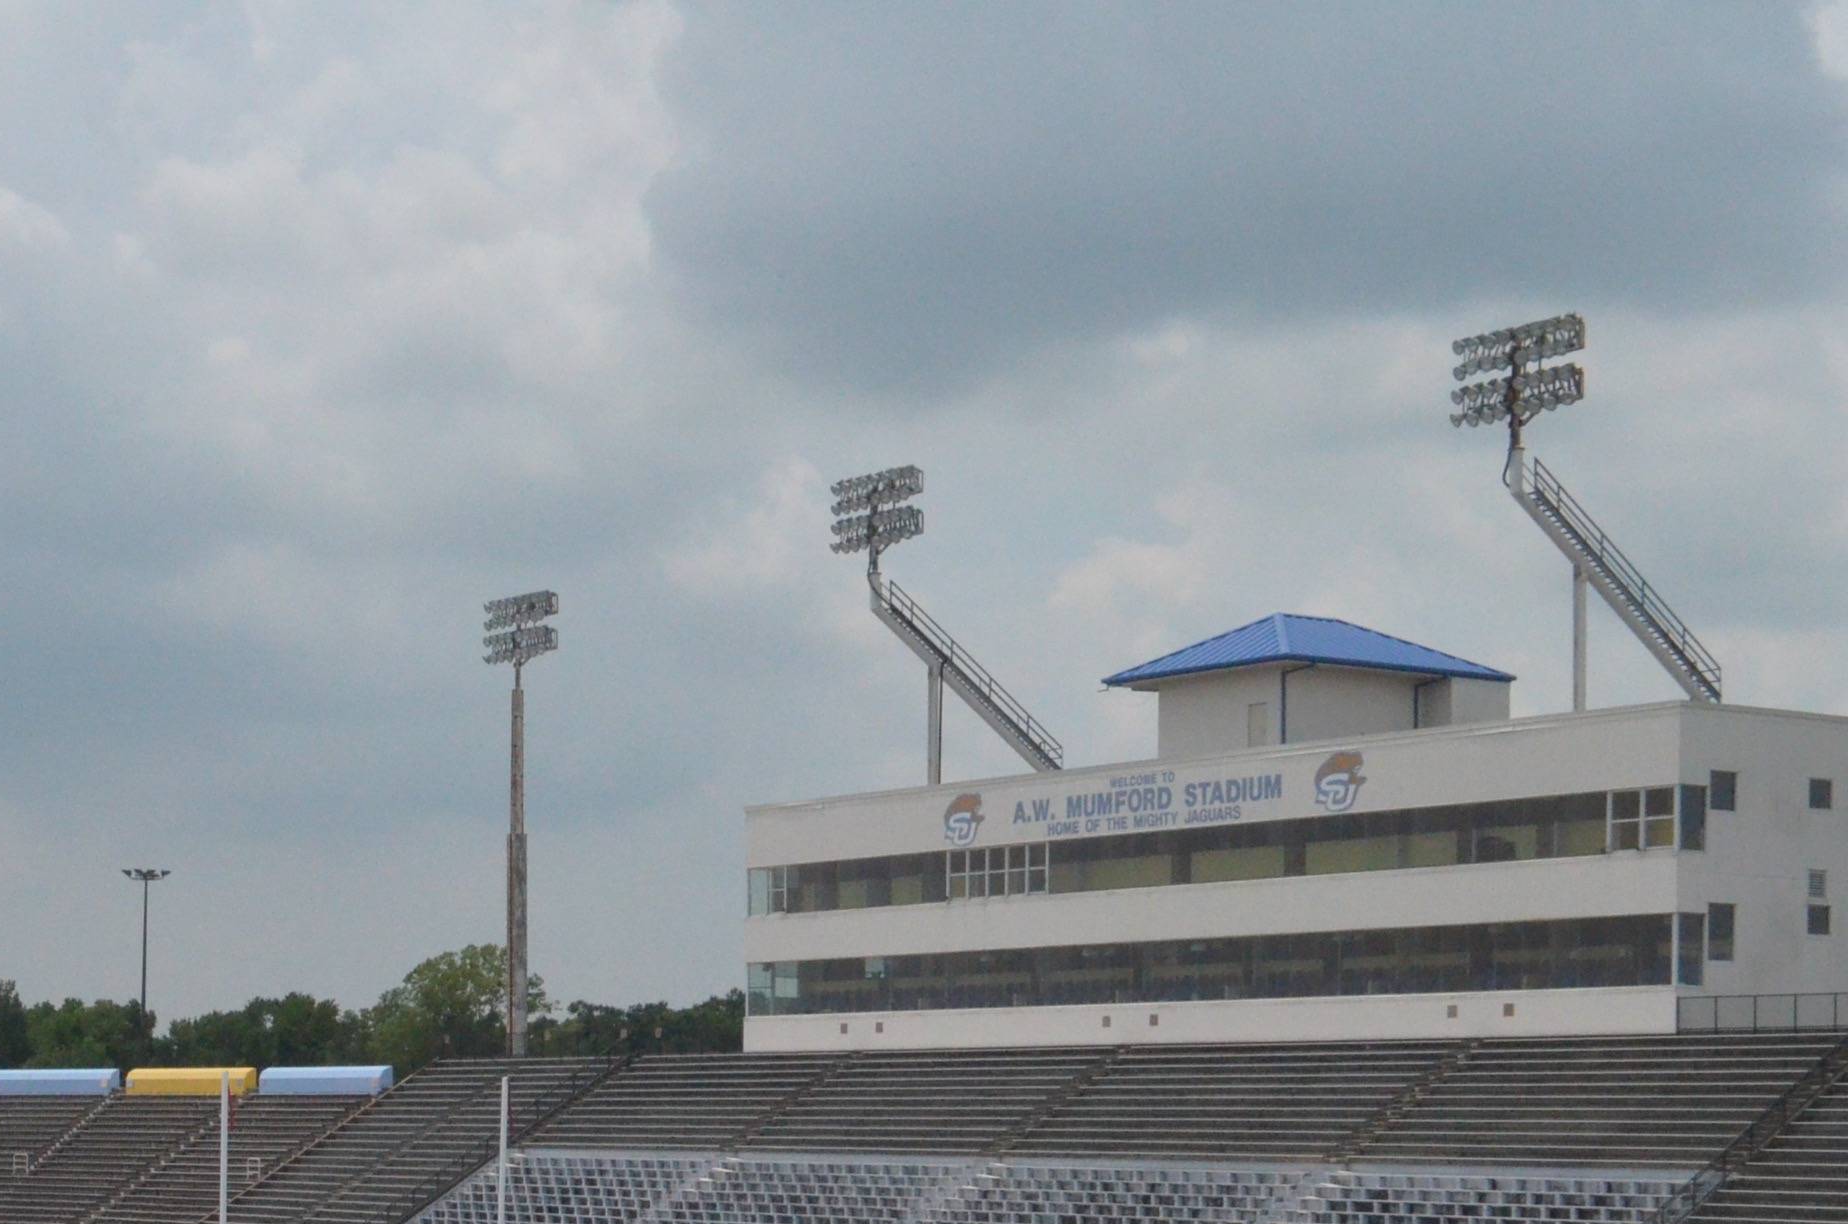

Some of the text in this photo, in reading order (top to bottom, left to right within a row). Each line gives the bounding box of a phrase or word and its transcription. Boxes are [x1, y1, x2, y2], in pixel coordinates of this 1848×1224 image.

[1110, 771, 1175, 788] WELCOME TO
[1013, 774, 1283, 824] A.W. MUMFORD STADIUM
[1047, 805, 1241, 837] HOME OF THE MIGHTY JAGUARS
